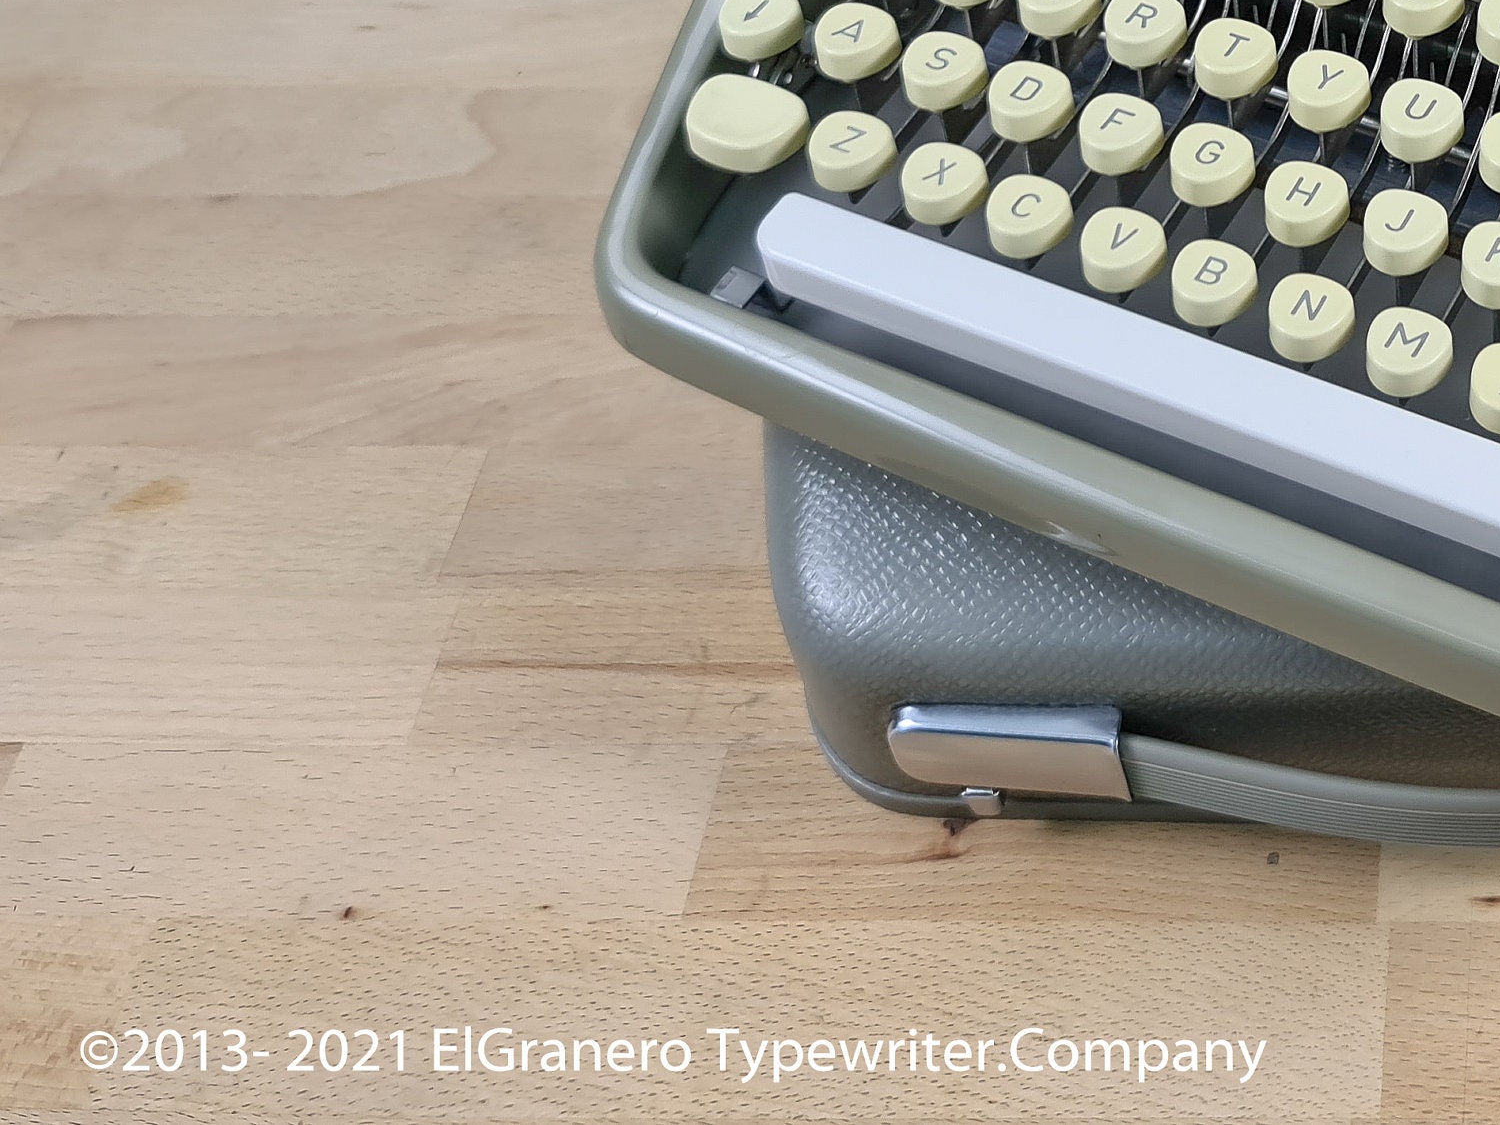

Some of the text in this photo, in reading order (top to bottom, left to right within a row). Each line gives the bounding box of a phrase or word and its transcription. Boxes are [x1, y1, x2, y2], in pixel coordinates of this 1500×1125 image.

[1124, 2, 1158, 29] R
[831, 19, 864, 43] A
[1223, 32, 1251, 57] T
[925, 48, 958, 70] S
[1009, 76, 1043, 101] D
[1317, 64, 1345, 90] Y
[1099, 108, 1136, 130] F
[1404, 93, 1438, 120] U
[829, 125, 867, 153] Z
[1194, 140, 1225, 165] G
[921, 158, 957, 186] X
[1285, 176, 1322, 207] H
[1011, 193, 1041, 218] C
[1384, 209, 1415, 232] J
[1110, 223, 1139, 250] V
[1193, 255, 1228, 285] B
[1290, 289, 1328, 321] N
[1384, 322, 1430, 358] M
